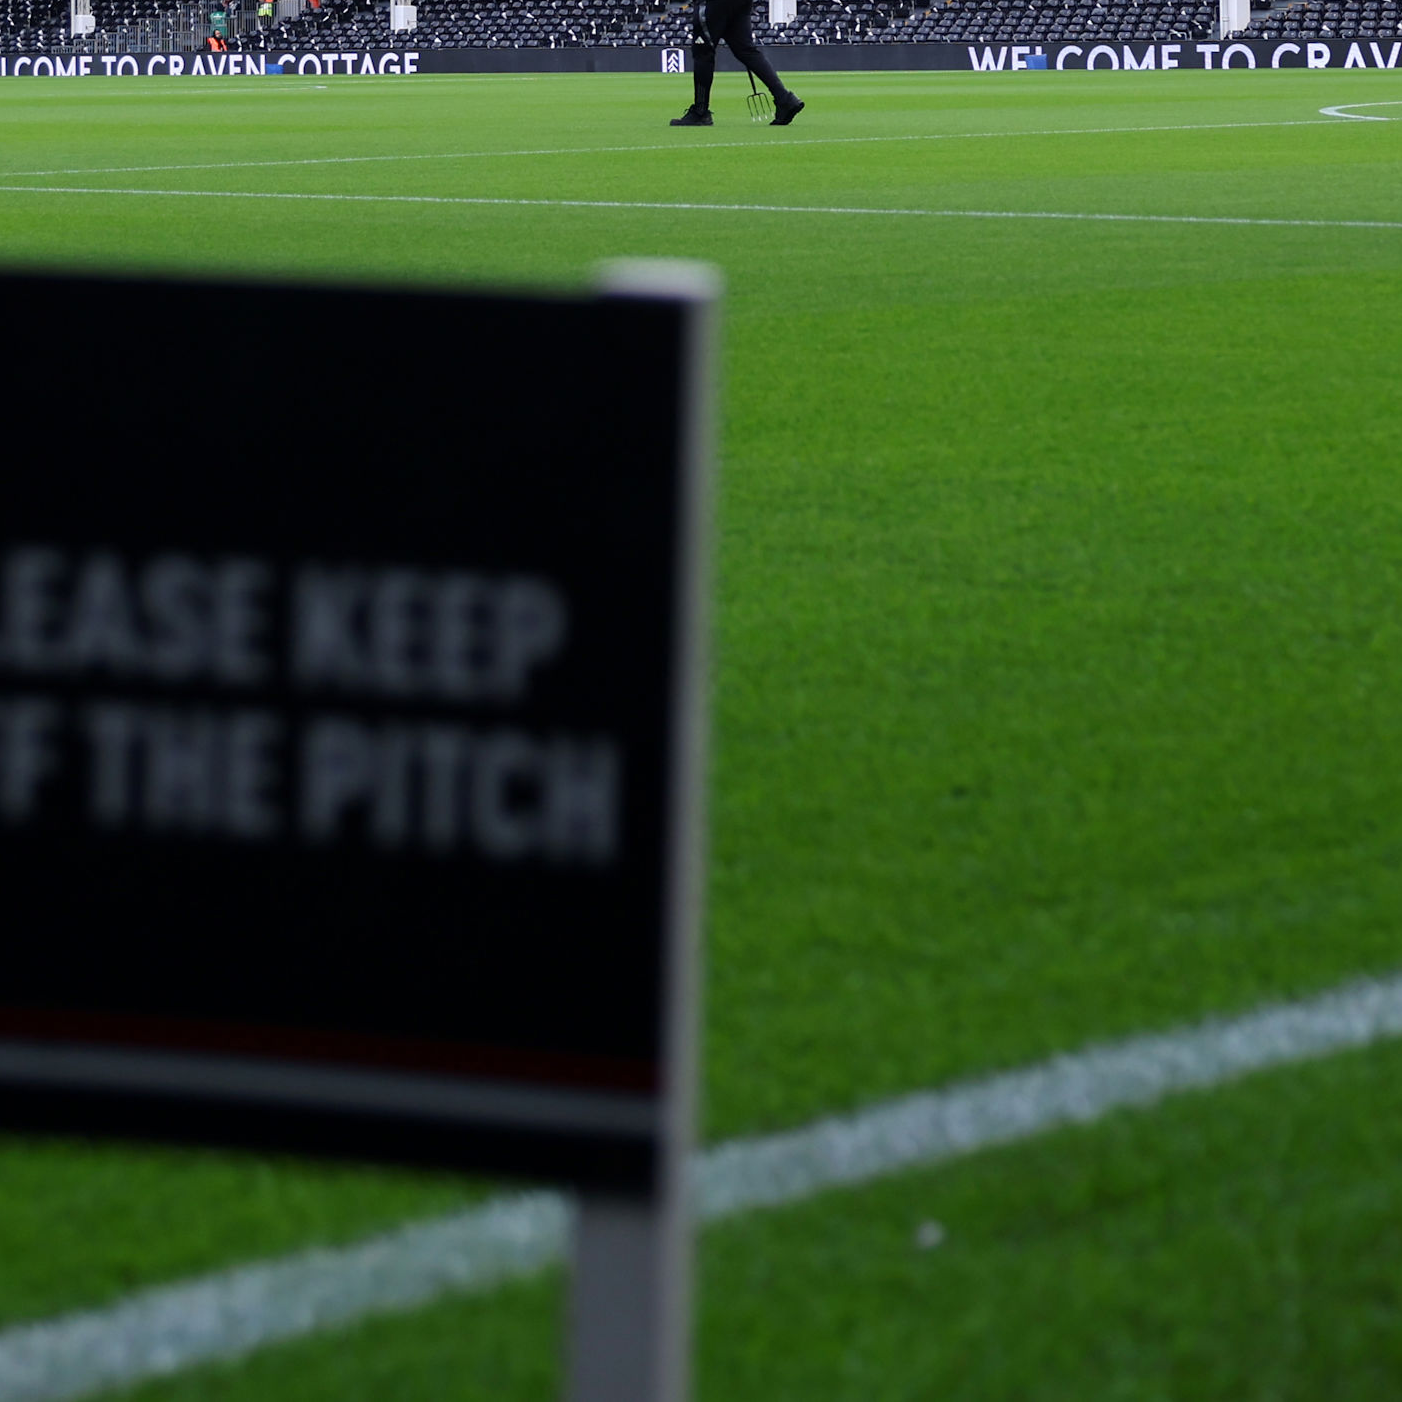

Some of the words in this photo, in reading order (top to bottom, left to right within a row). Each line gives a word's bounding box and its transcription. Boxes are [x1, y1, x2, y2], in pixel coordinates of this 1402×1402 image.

[101, 55, 139, 77] TO
[147, 54, 266, 76] CRAVEN
[277, 52, 420, 75] COTTAGE
[1196, 43, 1256, 70] TO
[290, 558, 570, 708] KEEP
[84, 700, 290, 840] THE
[302, 714, 624, 870] PITCH
